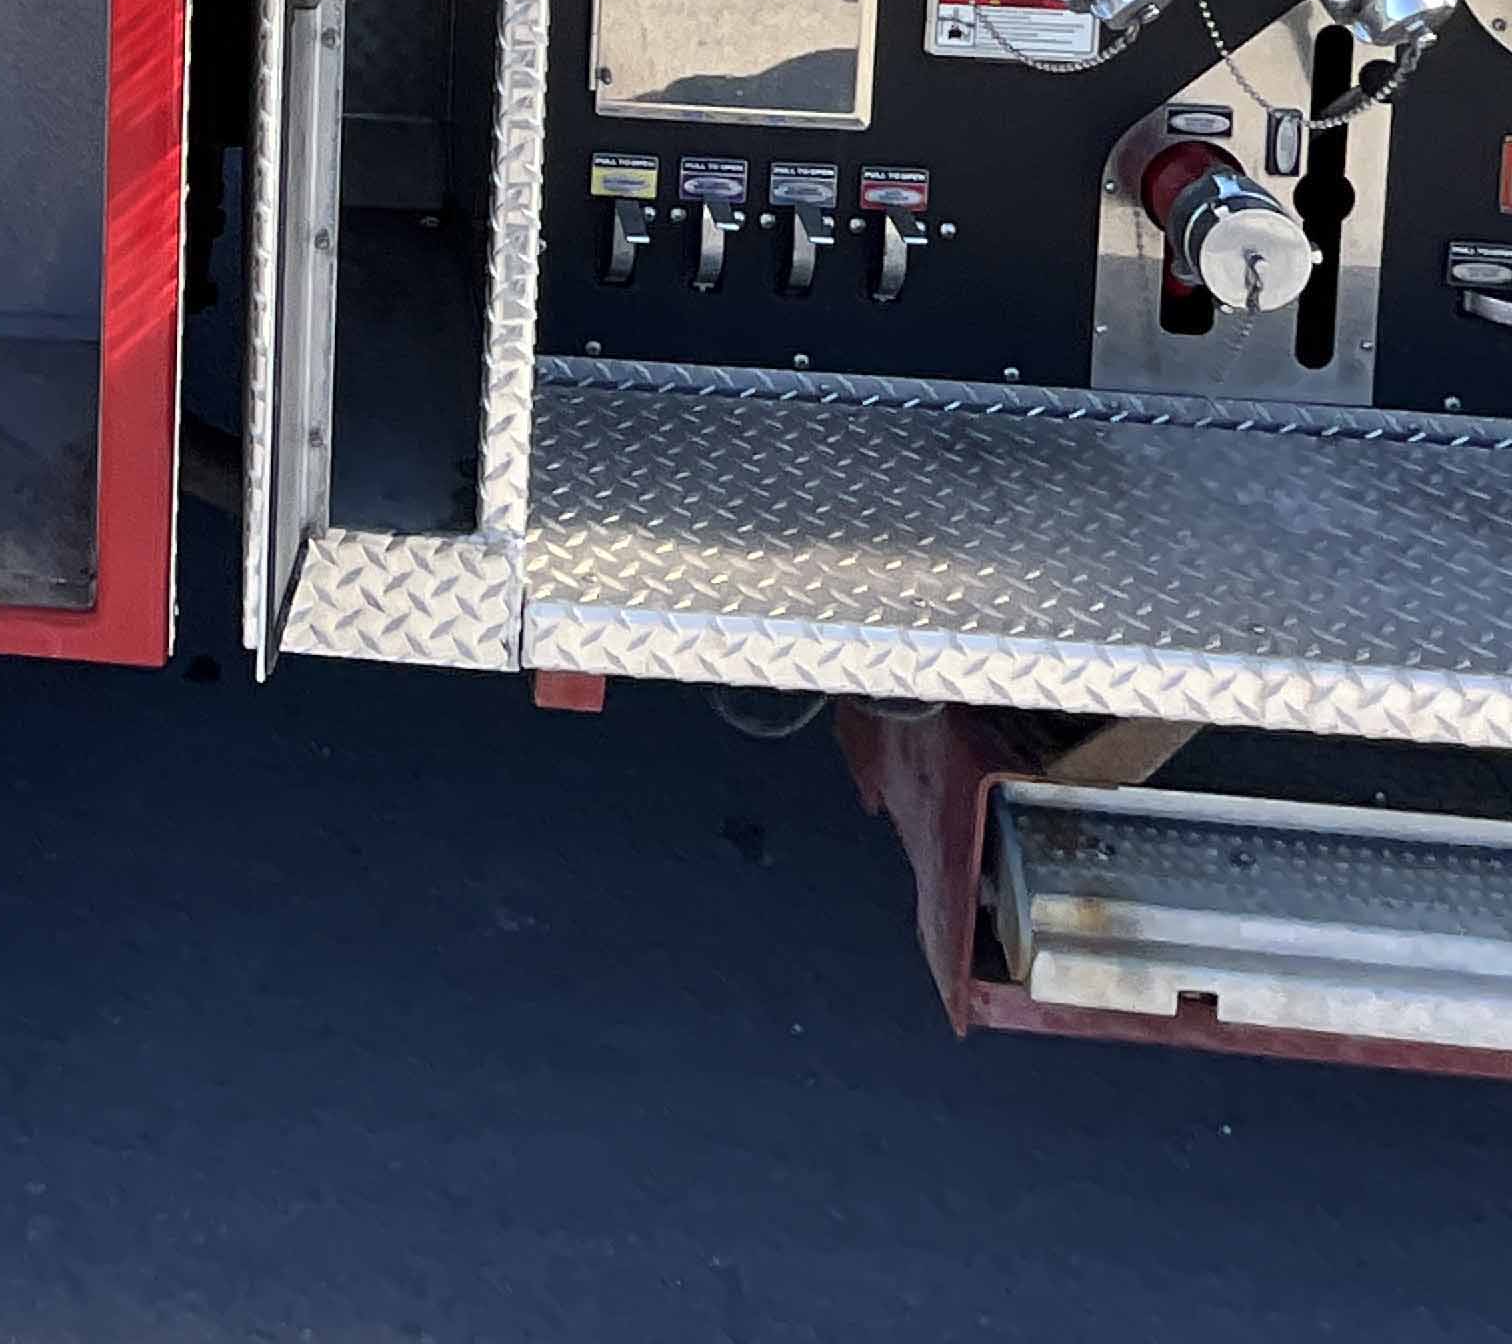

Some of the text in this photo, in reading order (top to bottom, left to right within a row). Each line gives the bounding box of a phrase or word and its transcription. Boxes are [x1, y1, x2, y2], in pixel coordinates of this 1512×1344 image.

[595, 158, 617, 166] PULL
[685, 162, 744, 172] PULL TO OPEN
[773, 168, 795, 176] PULL
[796, 168, 808, 176] TO
[864, 171, 926, 181] PULL TO OPEN
